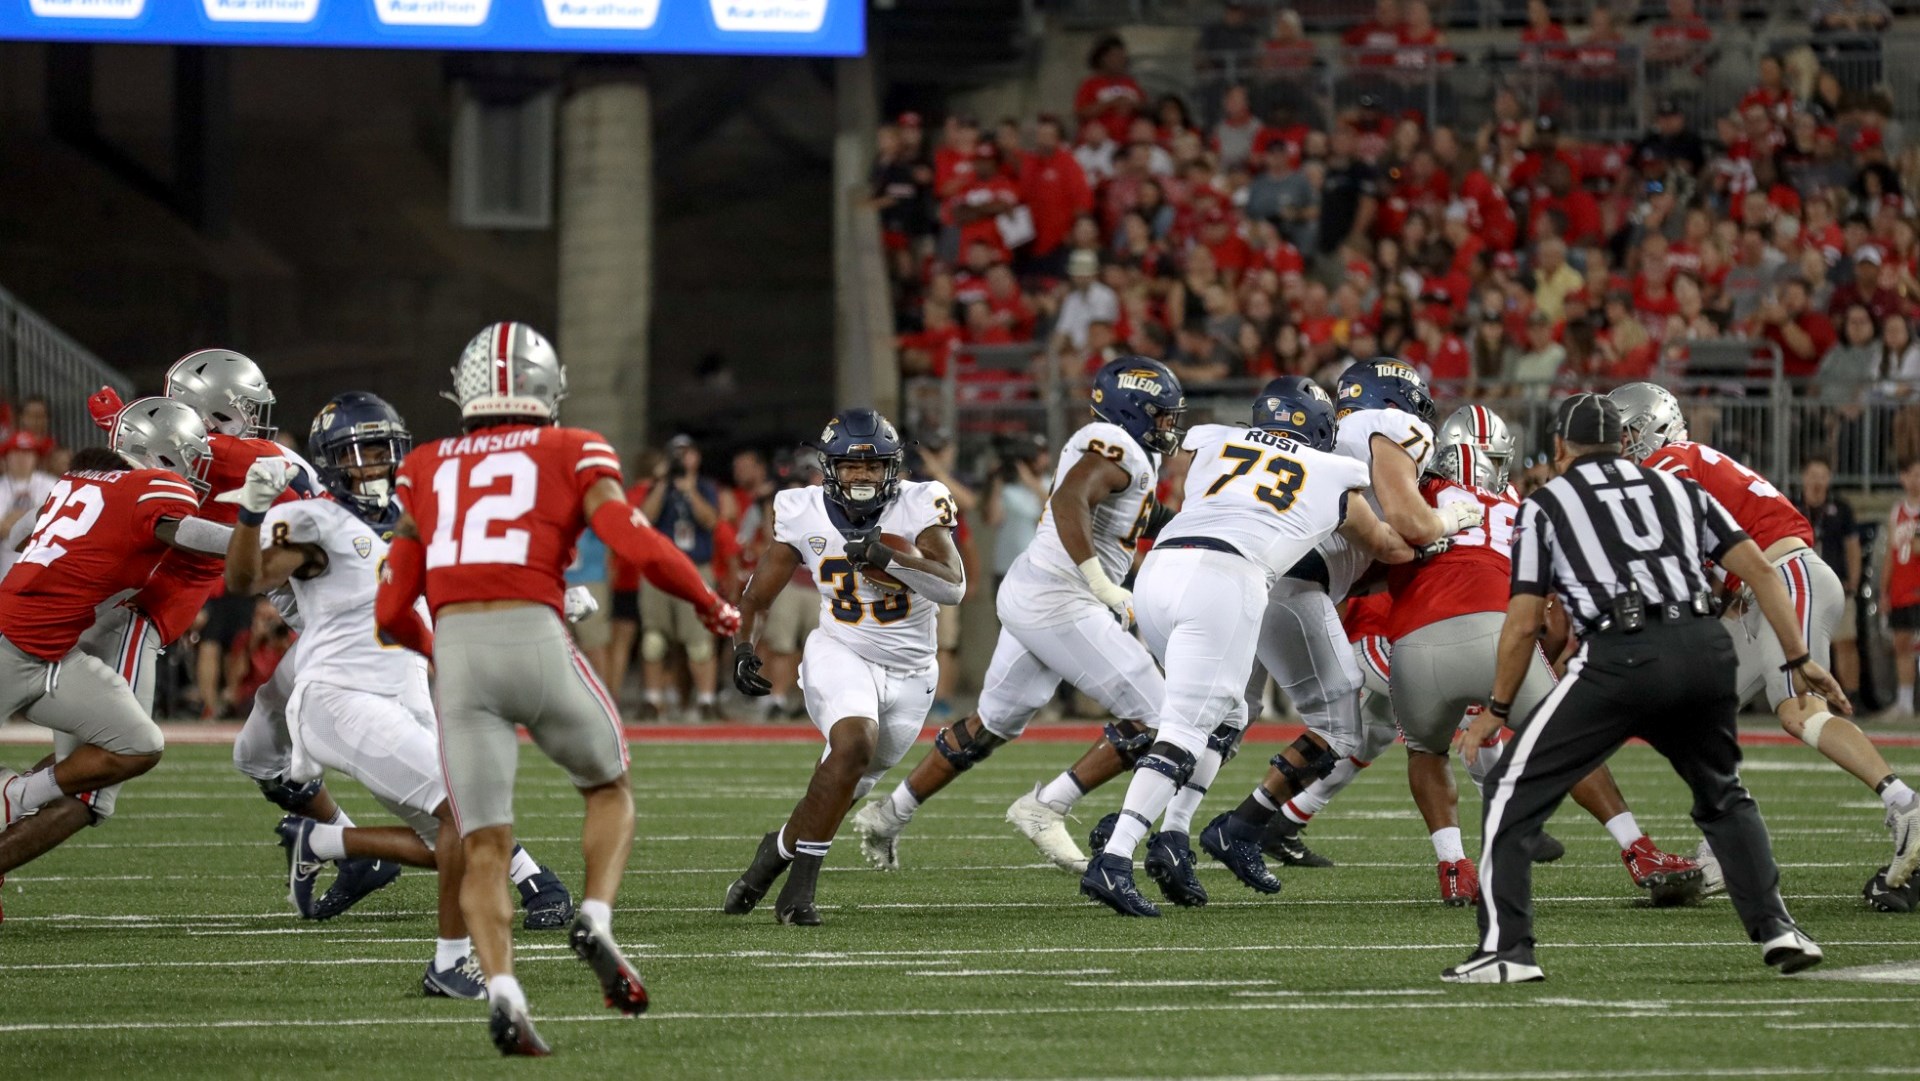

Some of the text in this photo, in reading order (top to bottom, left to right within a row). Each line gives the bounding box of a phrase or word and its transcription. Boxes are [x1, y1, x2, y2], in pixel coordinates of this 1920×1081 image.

[1117, 373, 1163, 397] TOLEDO
[1375, 364, 1421, 387] TOLEDO
[437, 428, 542, 458] RANSOM
[1244, 430, 1300, 455] ROSI
[1400, 425, 1431, 464] 71
[1201, 442, 1308, 515] 73
[15, 480, 105, 568] 22
[426, 450, 539, 571] 12
[1593, 484, 1665, 553] U
[271, 521, 290, 546] 8
[1667, 604, 1681, 620] S
